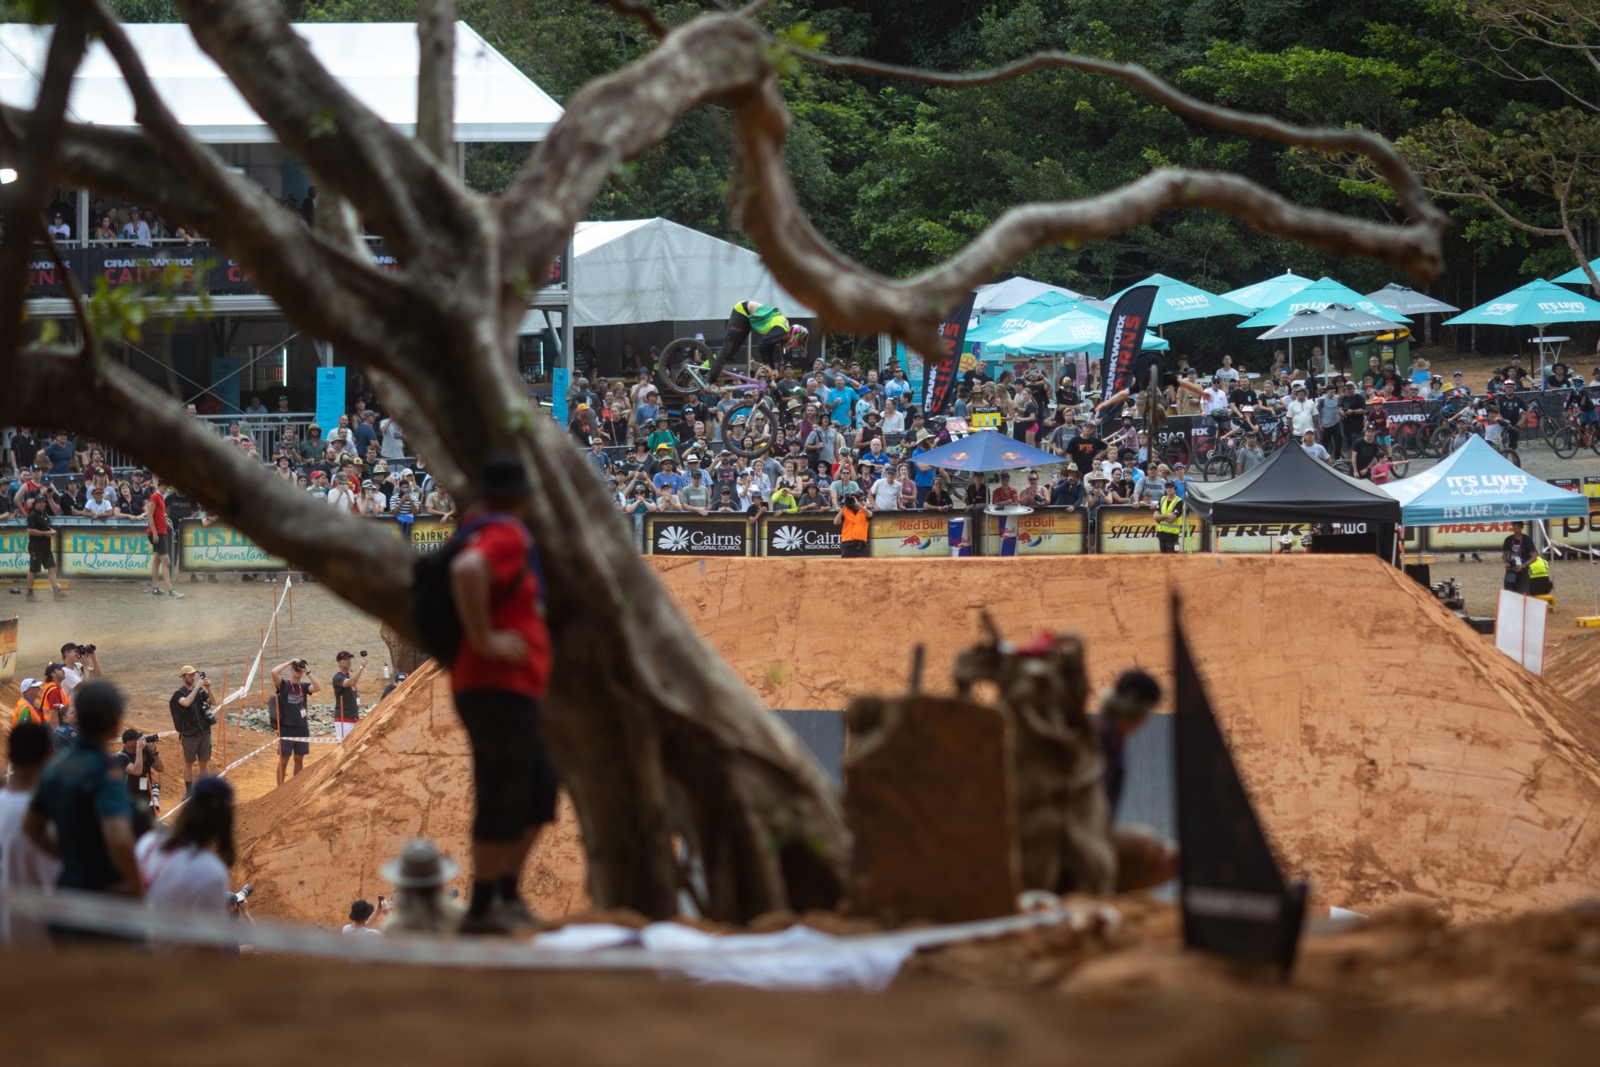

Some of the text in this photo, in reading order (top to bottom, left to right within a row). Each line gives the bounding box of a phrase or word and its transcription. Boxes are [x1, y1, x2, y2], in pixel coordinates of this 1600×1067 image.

[1114, 315, 1141, 390] AIRNS
[1446, 475, 1479, 488] IT'S
[1481, 474, 1528, 487] LIVE!
[1465, 505, 1492, 518] LIVE!
[413, 531, 449, 541] CAIRNS
[1216, 524, 1305, 537] TREK
[72, 535, 153, 555] IT'S LIVE
[690, 531, 742, 546] Cairns
[84, 551, 152, 570] Queensland
